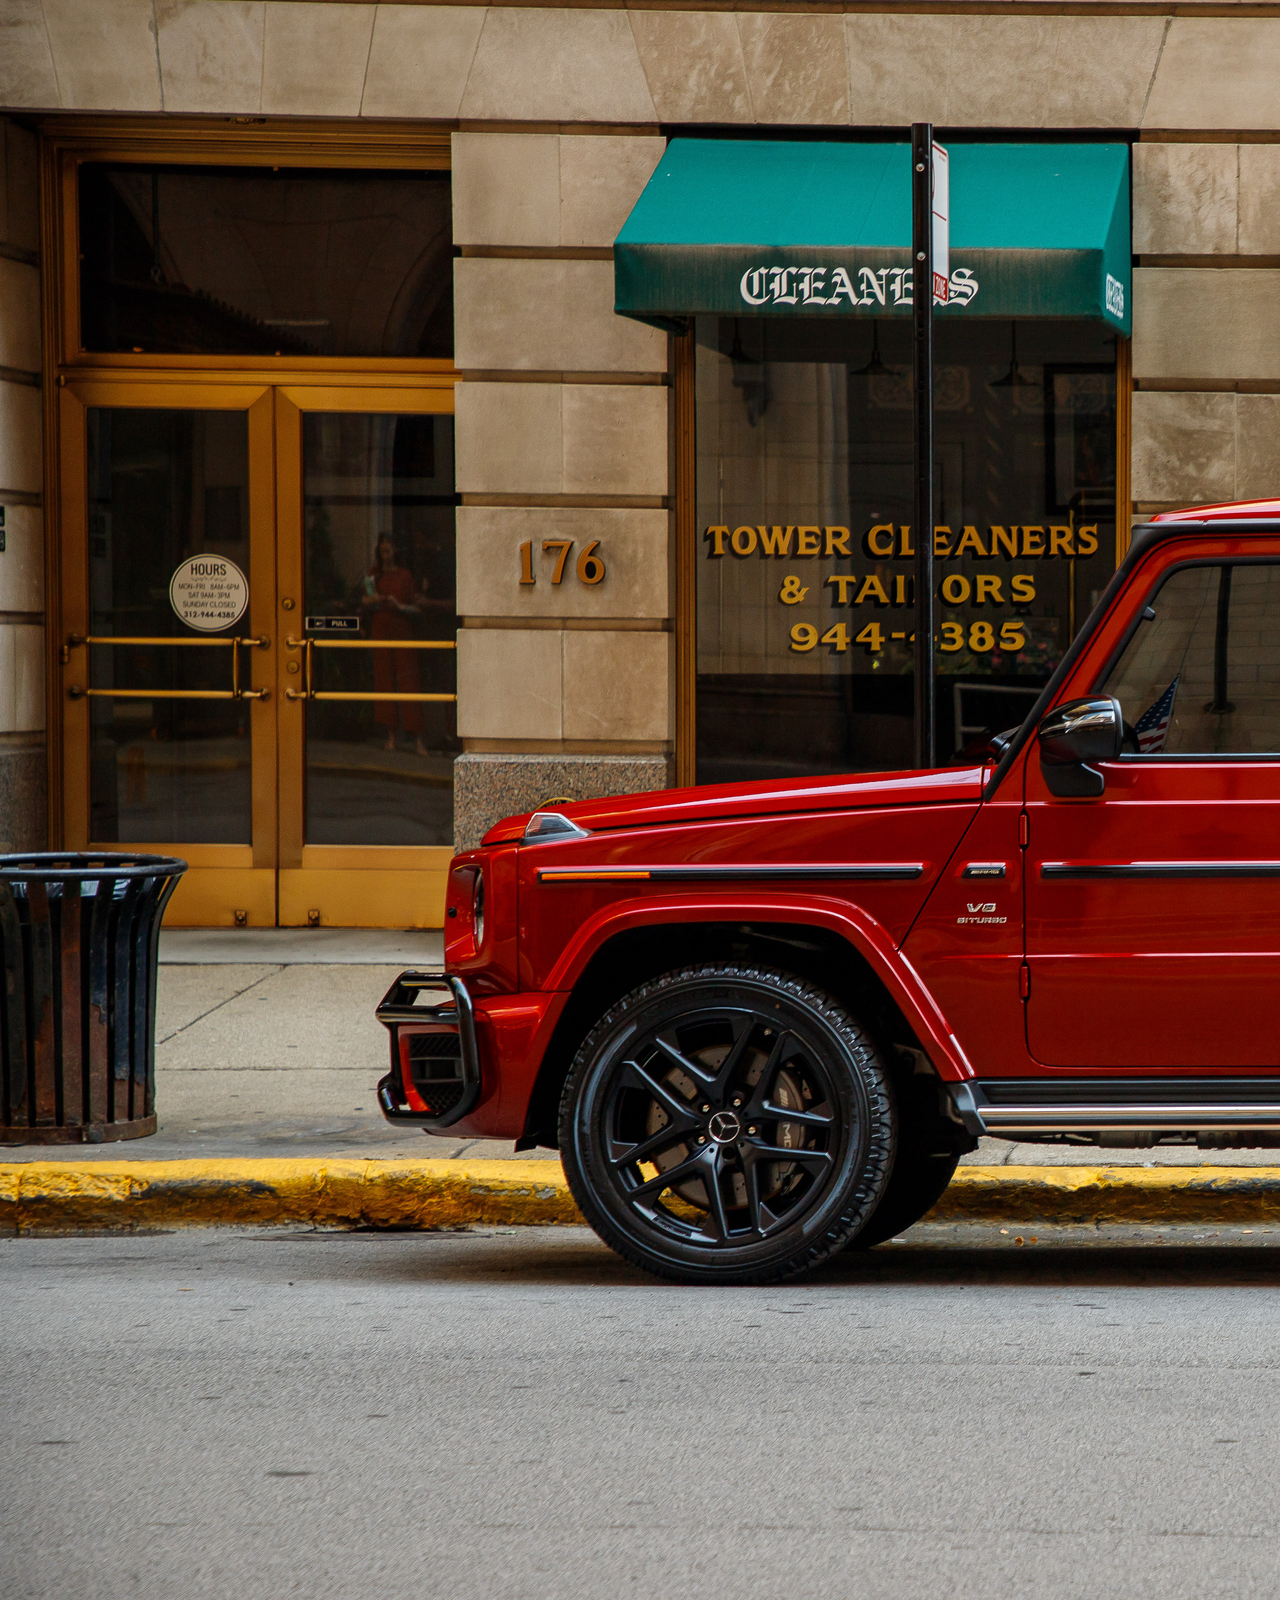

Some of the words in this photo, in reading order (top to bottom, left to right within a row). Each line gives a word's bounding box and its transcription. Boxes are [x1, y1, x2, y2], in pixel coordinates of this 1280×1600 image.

[740, 266, 980, 307] CLEANES
[705, 525, 852, 556] TOWER
[867, 523, 1099, 558] CLEANERS
[191, 564, 226, 576] HOURS
[519, 540, 606, 585] 176
[779, 575, 810, 605] &
[827, 574, 1037, 605] TAIORS
[182, 600, 208, 608] SUNDAY
[183, 611, 236, 619] 312-944-4385
[331, 619, 348, 627] PULL
[790, 621, 1026, 652] 944-385
[966, 902, 996, 913] V8
